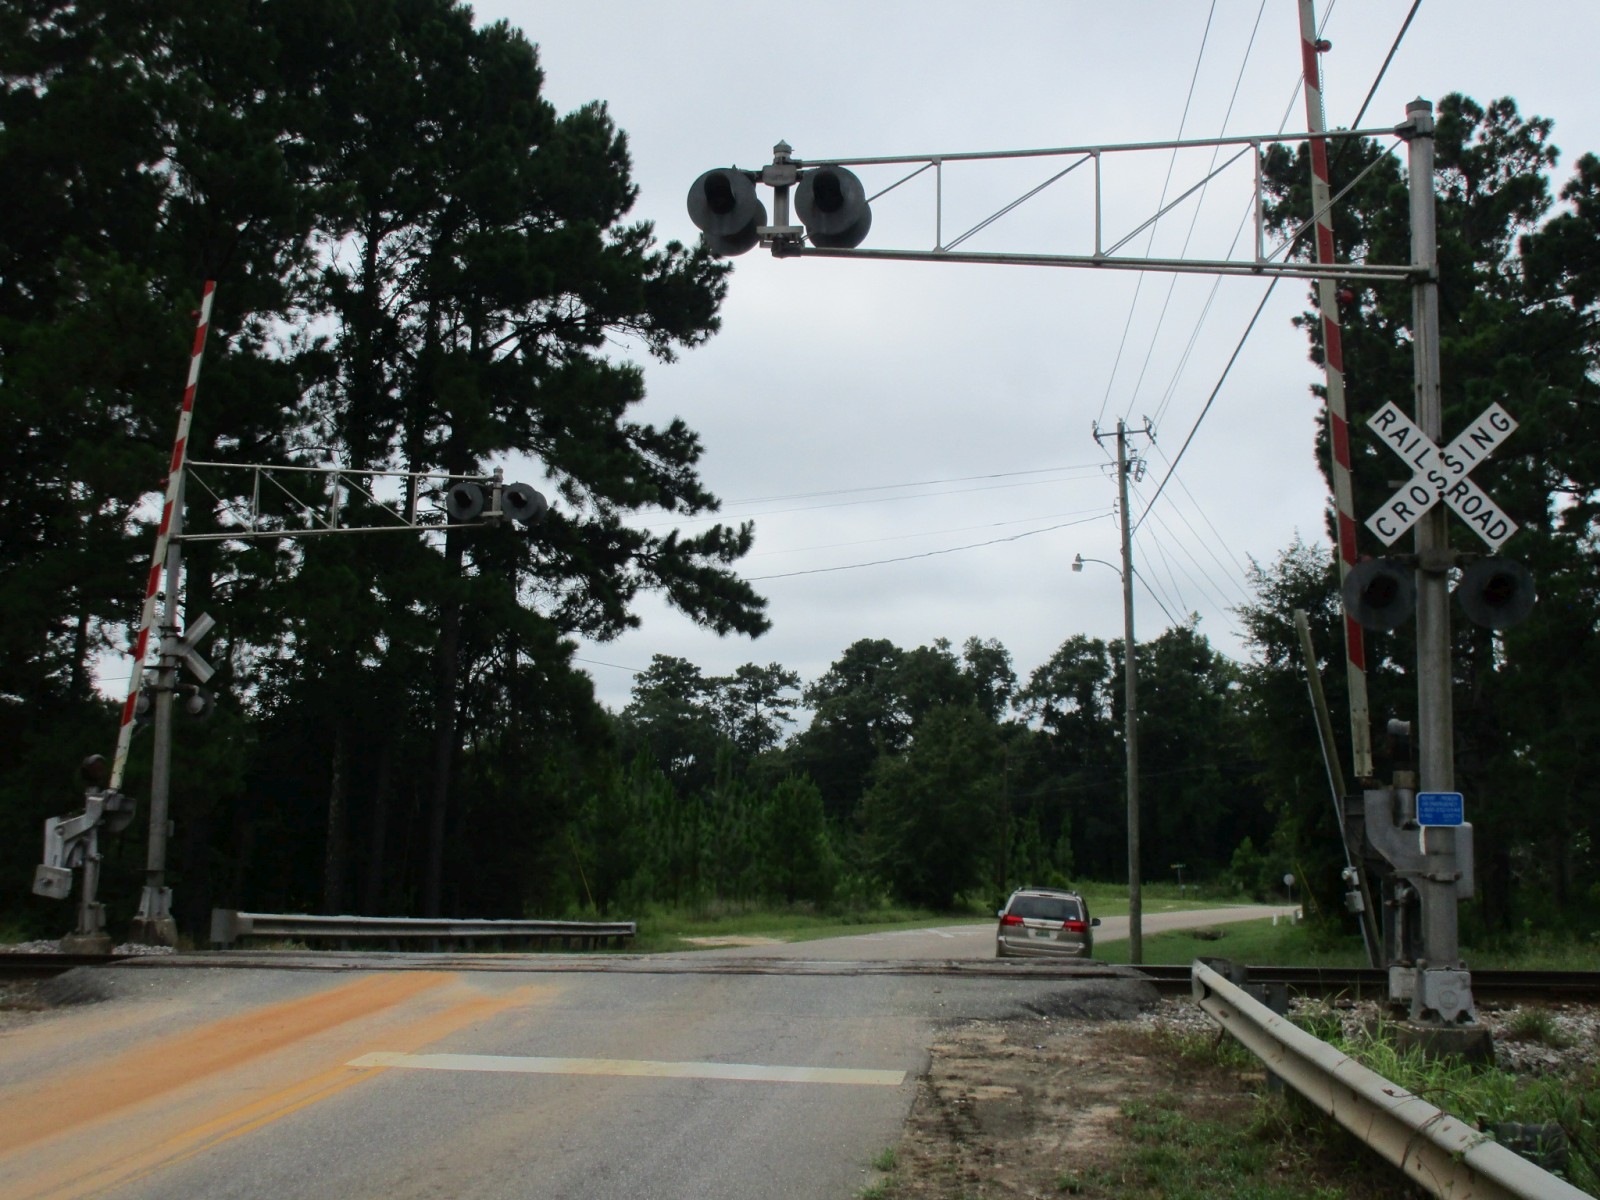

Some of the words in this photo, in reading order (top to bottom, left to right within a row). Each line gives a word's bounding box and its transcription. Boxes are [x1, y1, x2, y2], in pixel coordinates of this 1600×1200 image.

[1374, 409, 1430, 469] RAIL
[1447, 481, 1507, 540] ROAD
[1376, 412, 1510, 537] CROSSING
